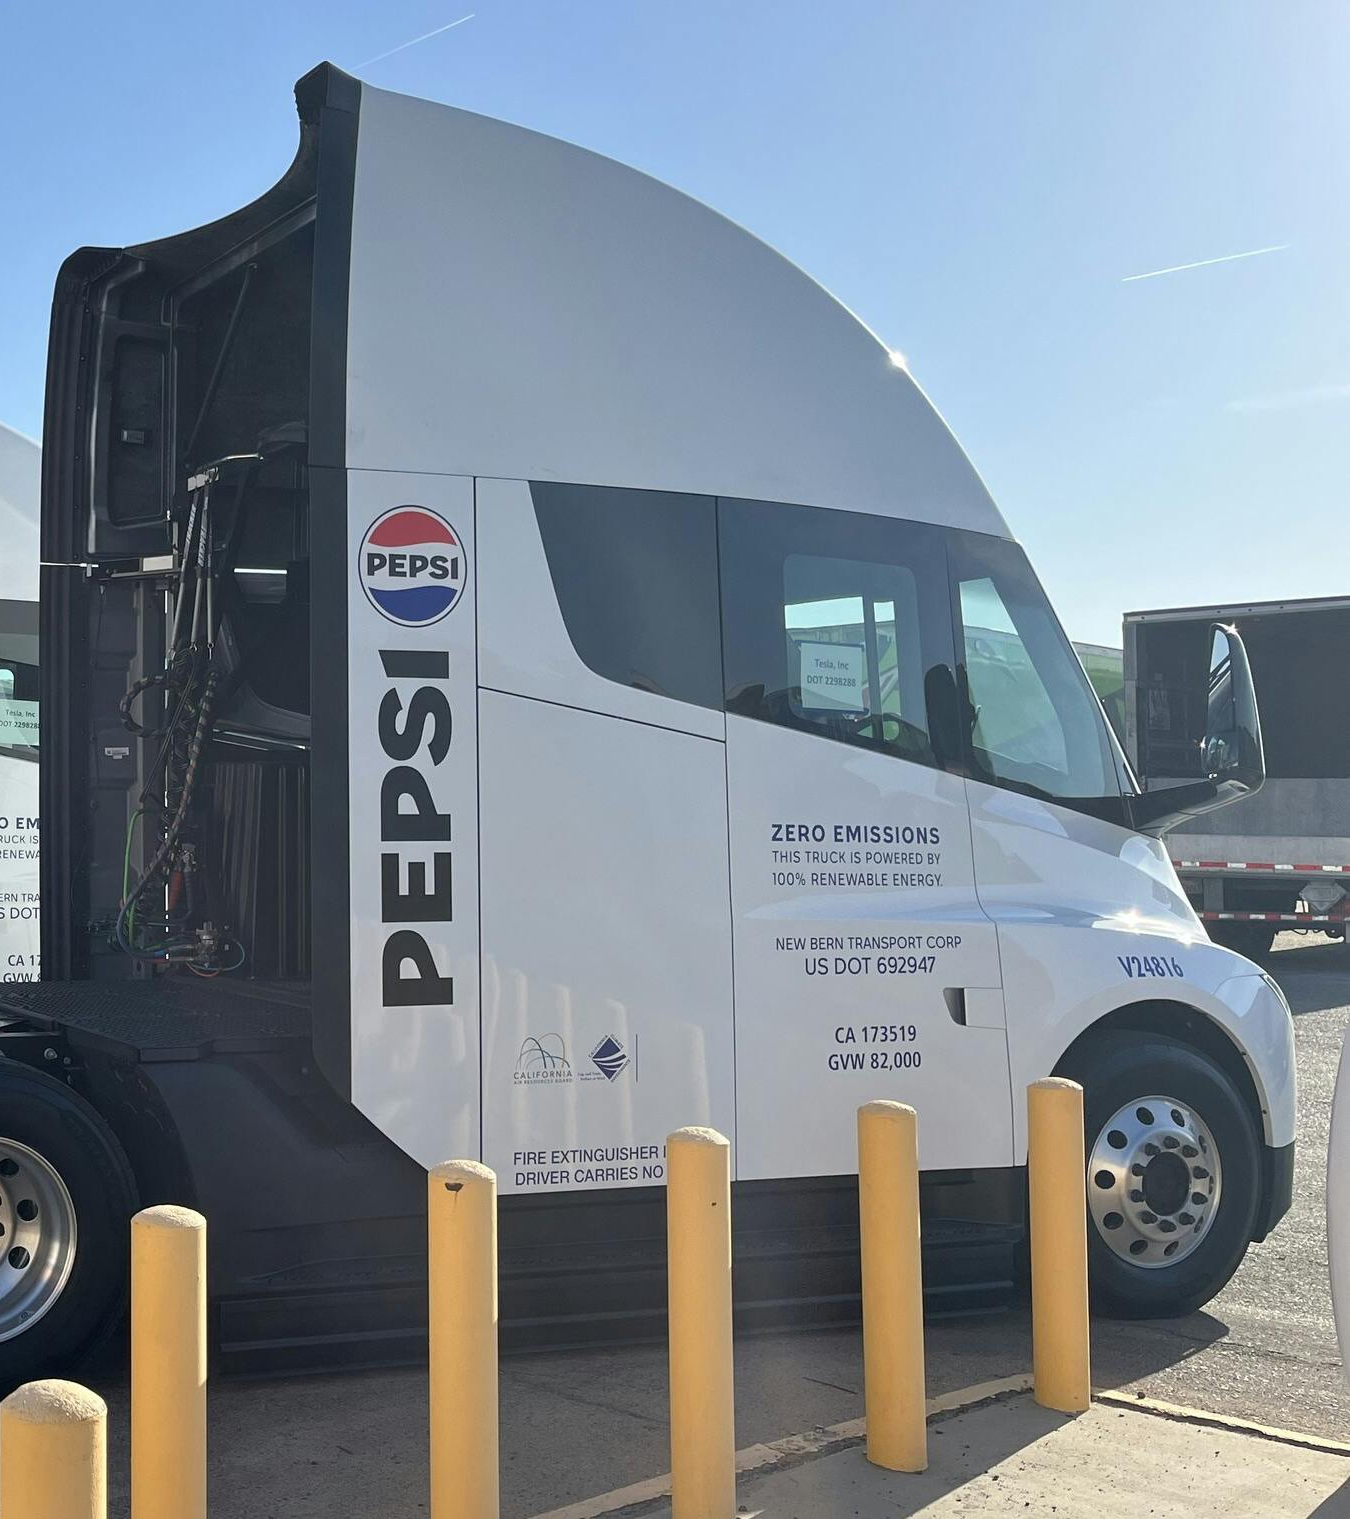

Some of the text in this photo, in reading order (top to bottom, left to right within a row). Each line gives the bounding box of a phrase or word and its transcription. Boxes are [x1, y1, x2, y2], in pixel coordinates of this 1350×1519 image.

[367, 553, 458, 580] PEPSI
[815, 659, 849, 670] Tesla, Inc
[807, 675, 822, 684] DOT
[378, 649, 453, 1007] PEPSI
[771, 824, 939, 844] ZERO EMISSIONS
[772, 851, 940, 865] THIS TRUCK IS POWERED BY
[773, 873, 943, 886] 100% RENEWABLE ENERGY.
[776, 936, 961, 950] NEW BERN TRANSPORT CORP
[8, 955, 24, 966] CA
[805, 956, 936, 975] US DOT 692947
[1117, 956, 1183, 977] V24816
[835, 1025, 916, 1043] CA 173519
[828, 1052, 921, 1071] GVW 82,000
[513, 1071, 572, 1080] CALIFORNIA
[514, 1152, 546, 1165] FIRE
[551, 1146, 658, 1164] EXTINGUISHER
[516, 1166, 663, 1185] DRIVER CARRIES NO
